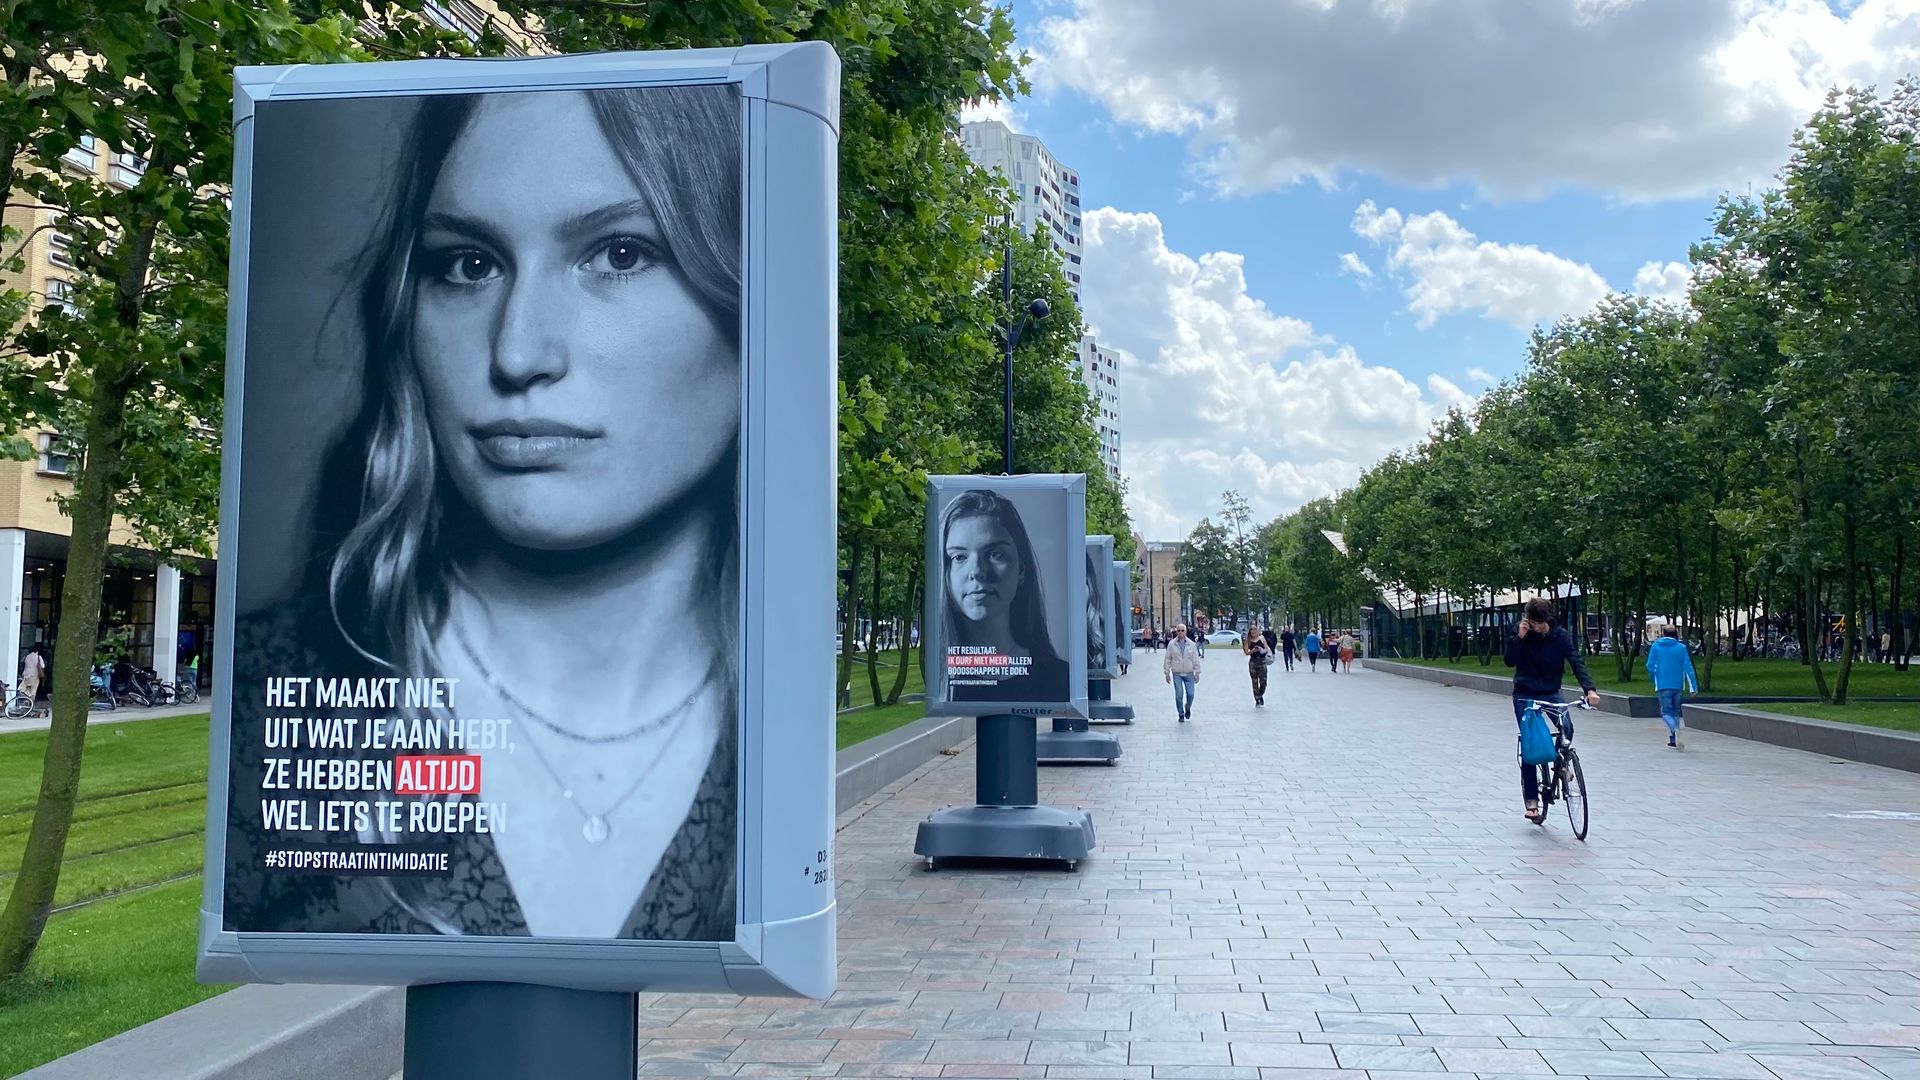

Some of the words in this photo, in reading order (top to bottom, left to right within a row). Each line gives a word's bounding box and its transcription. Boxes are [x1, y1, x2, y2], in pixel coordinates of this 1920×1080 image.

[948, 646, 960, 655] HET
[961, 646, 997, 655] RESULTAAT:
[948, 656, 955, 665] IK
[956, 656, 973, 665] DURF
[973, 656, 989, 665] NIET
[989, 656, 1008, 665] MEER
[1008, 656, 1032, 665] ALLEEN
[1001, 667, 1009, 675] TE
[266, 677, 311, 708] HET
[315, 677, 400, 708] MAAKT
[405, 678, 460, 708] NIET
[1011, 707, 1052, 715] trotter
[264, 718, 303, 748] UIT
[307, 718, 358, 749] WAT
[360, 719, 387, 749] JE
[391, 719, 441, 749] AAN
[448, 719, 515, 754] HEBT,
[262, 758, 290, 789] ZE
[296, 759, 392, 790] HEBBEN
[397, 760, 475, 791] ALTIJD
[261, 799, 313, 831] WEL
[318, 801, 369, 832] IETS
[375, 802, 403, 832] TE
[408, 802, 506, 833] ROEPEN
[265, 850, 448, 870] #STOPSTRAATINTIMIDATIE
